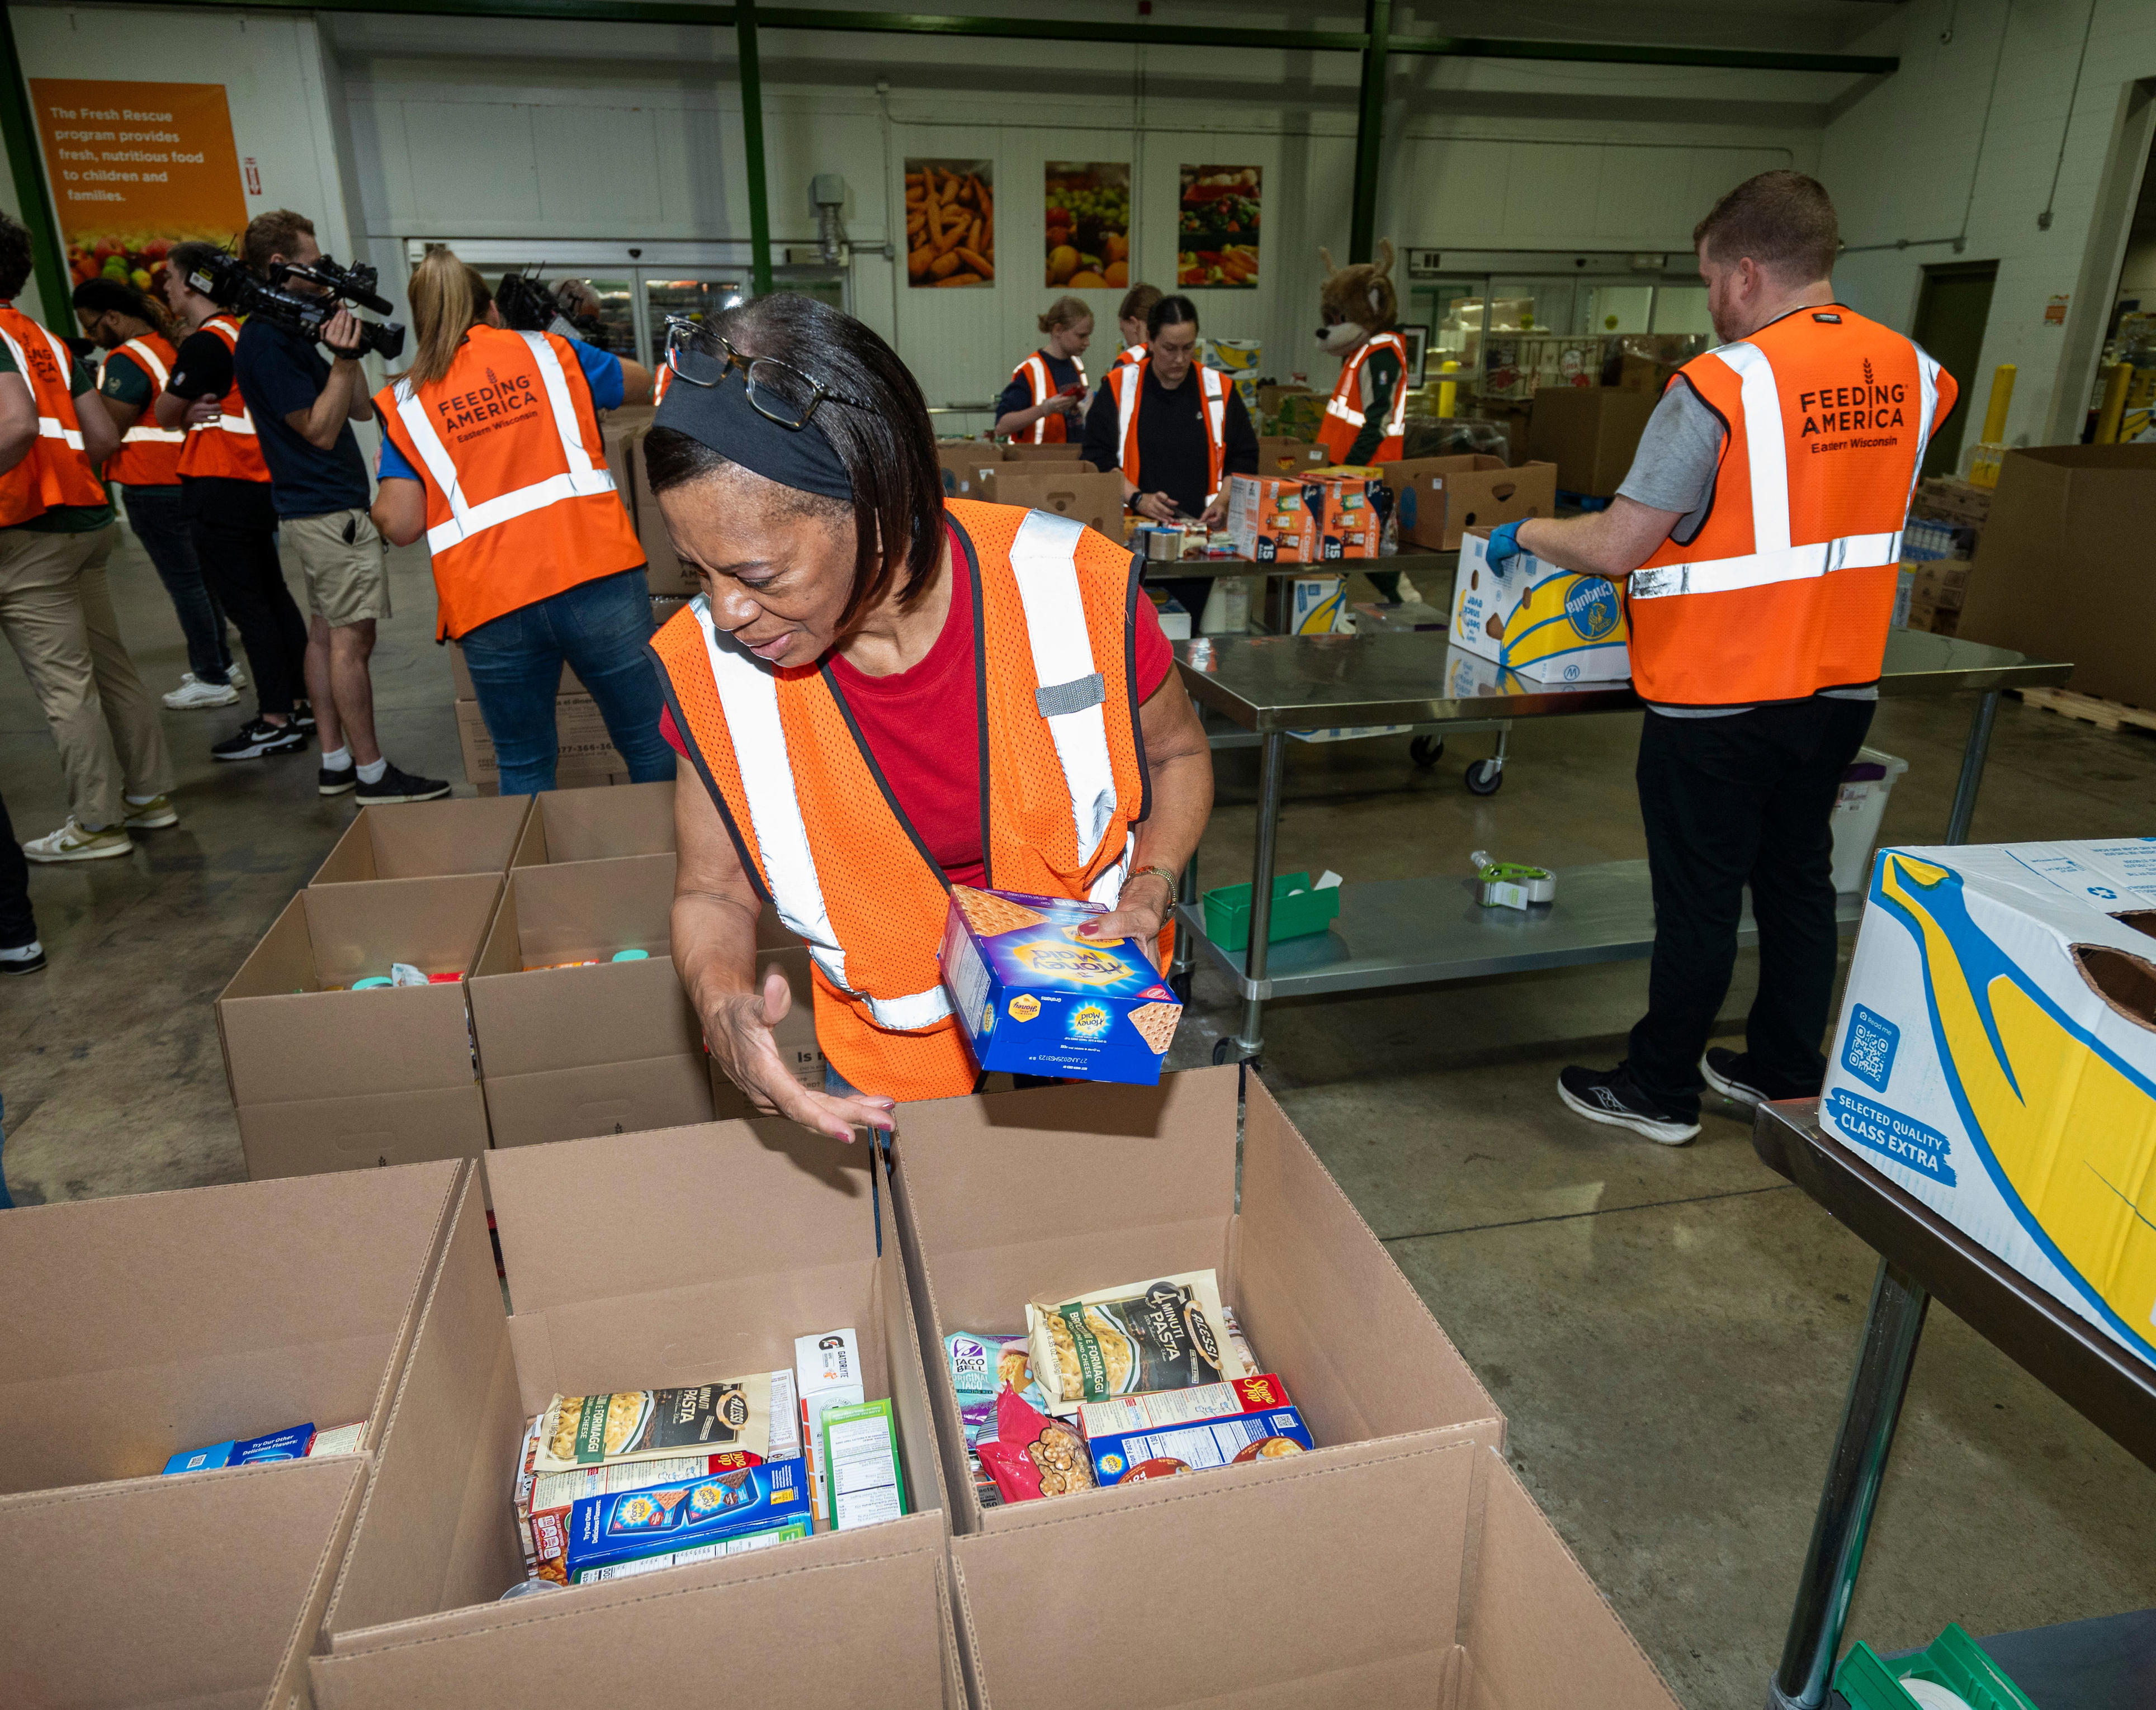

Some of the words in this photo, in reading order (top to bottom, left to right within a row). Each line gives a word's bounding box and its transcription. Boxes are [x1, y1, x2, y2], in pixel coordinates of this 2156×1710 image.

[50, 107, 76, 119] The
[81, 108, 120, 120] Fresh
[122, 109, 172, 122] Rescue
[55, 130, 115, 141] program
[119, 131, 179, 143] provides
[59, 148, 98, 163] fresh,
[102, 150, 168, 163] nutritious
[171, 151, 204, 163] food
[63, 169, 79, 181] to
[83, 170, 139, 182] children
[142, 171, 168, 182] and
[68, 189, 126, 201] families.
[438, 375, 530, 416] FEEDING
[1800, 385, 1905, 413] FEEDING
[446, 391, 537, 433] AMERICA
[457, 427, 491, 443] Eastern
[492, 410, 537, 430] Wisconsin
[1801, 409, 1904, 437] AMERICA
[1850, 436, 1897, 449] Wisconsin
[1263, 544, 1274, 559] 15
[1330, 543, 1341, 558] 15
[1468, 596, 1483, 608] ever
[1566, 581, 1614, 614] Chiquita
[1464, 606, 1480, 618] snack
[1467, 619, 1480, 632] best
[1031, 949, 1103, 962] Maid
[1033, 957, 1123, 974] Honey
[1013, 1002, 1037, 1012] Honey
[1867, 1017, 1881, 1030] Read
[1882, 1026, 1892, 1036] me
[798, 1051, 812, 1063] Is
[1840, 1095, 1890, 1126] SELECTED
[1893, 1120, 1943, 1150] QUALITY
[1841, 1114, 1885, 1145] CLASS
[1888, 1136, 1939, 1172] EXTRA
[1151, 1291, 1177, 1304] 4
[1161, 1302, 1185, 1338] MINUTI
[1150, 1311, 1180, 1361] PASTA
[1191, 1313, 1218, 1358] ALESSI
[838, 1351, 849, 1378] GATORLYTE
[1052, 1359, 1061, 1375] (180g)
[1081, 1353, 1092, 1379] CHEESE
[1088, 1345, 1104, 1393] FORMAGGI
[952, 1373, 989, 1383] ORIGINAL
[962, 1381, 982, 1390] TACO
[1244, 1379, 1276, 1405] Stove
[1245, 1390, 1261, 1403] Top
[679, 1390, 698, 1424] PASTA
[730, 1398, 745, 1424] ALESSI
[580, 1416, 590, 1439] CHEESE
[588, 1409, 604, 1452] FORMAGGI
[243, 1446, 272, 1456] Delicious
[272, 1439, 298, 1448] Flavors:
[1124, 1439, 1133, 1454] Facts
[1150, 1436, 1159, 1445] 130
[718, 1453, 732, 1466] op
[732, 1452, 746, 1467] ove
[697, 1490, 712, 1508] Honey
[707, 1489, 718, 1502] Maid
